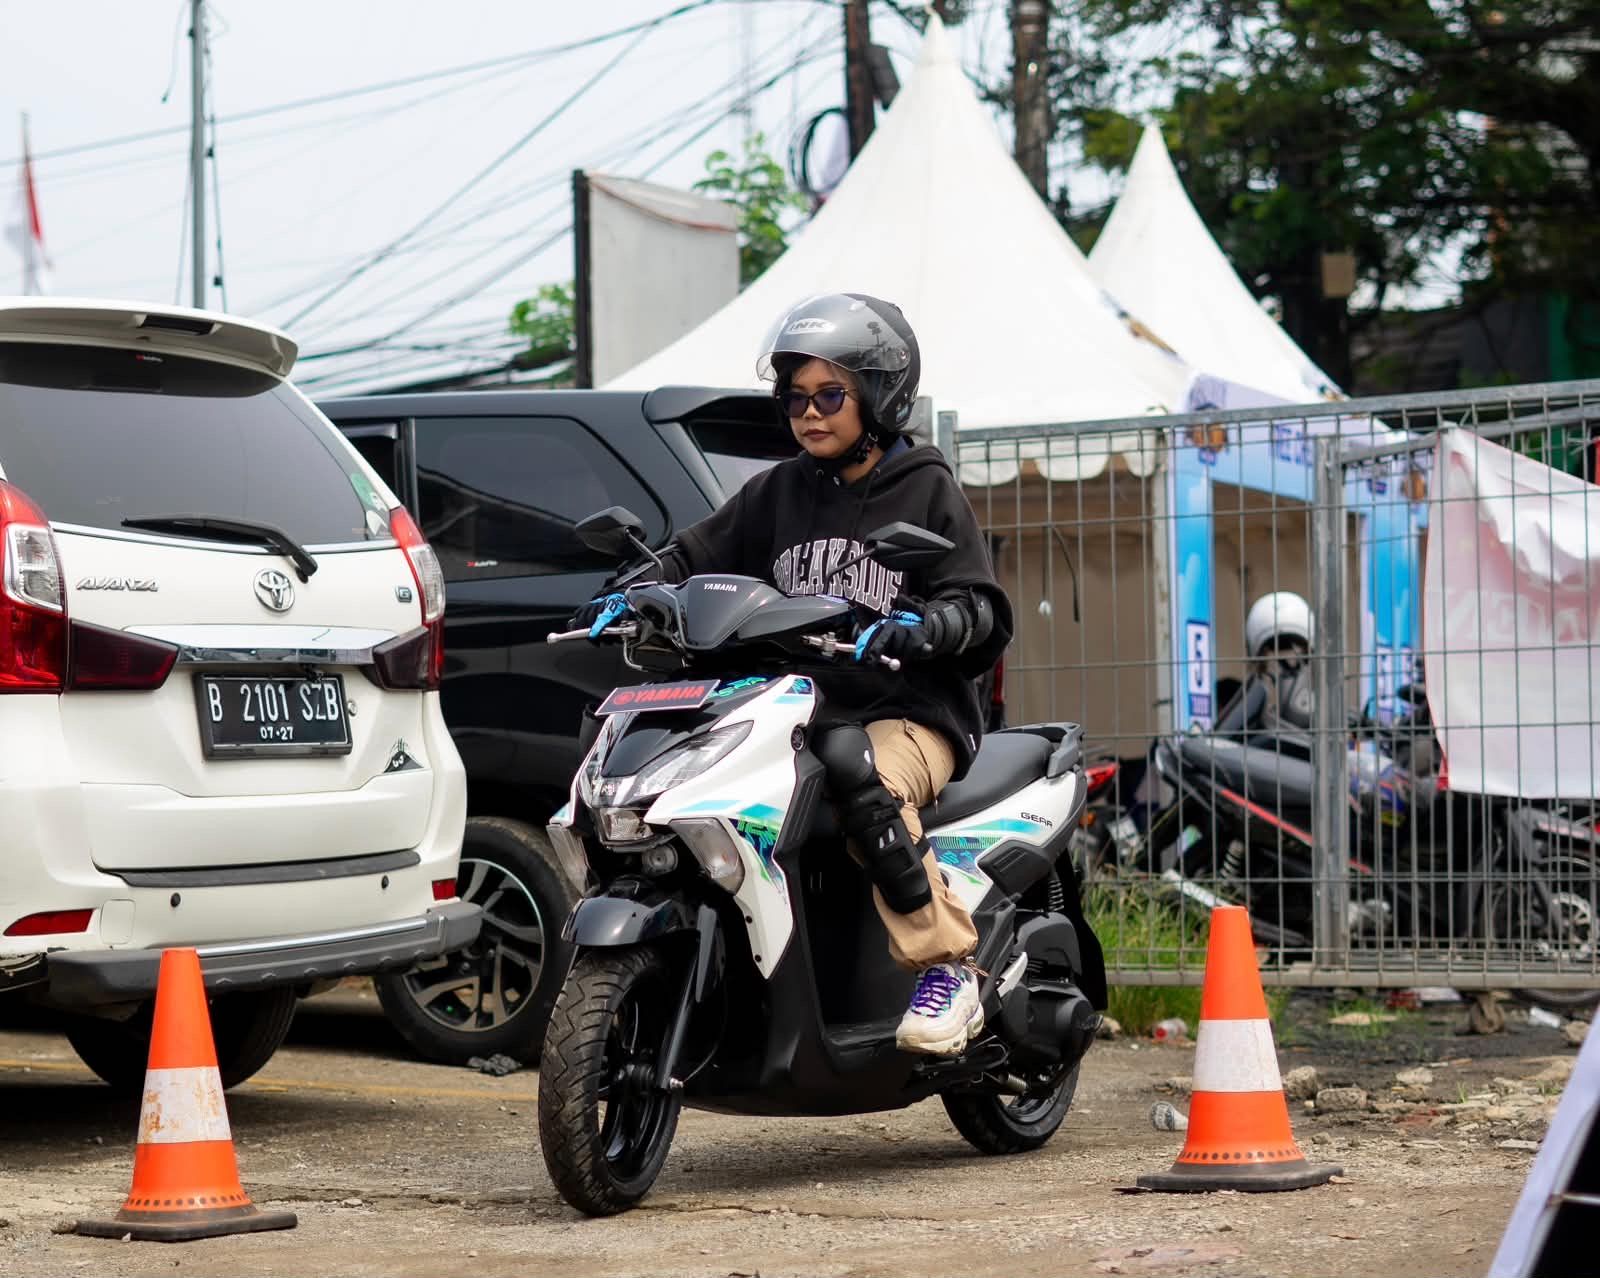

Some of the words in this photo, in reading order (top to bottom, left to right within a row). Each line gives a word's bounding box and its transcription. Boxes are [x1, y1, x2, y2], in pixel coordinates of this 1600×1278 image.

[76, 576, 159, 592] AVANZA
[704, 583, 738, 592] YAMAHA
[207, 683, 223, 722] B
[240, 683, 290, 722] 2101
[300, 683, 339, 722] SZB
[634, 685, 705, 703] YAMAHA
[1020, 811, 1053, 828] GEAR
